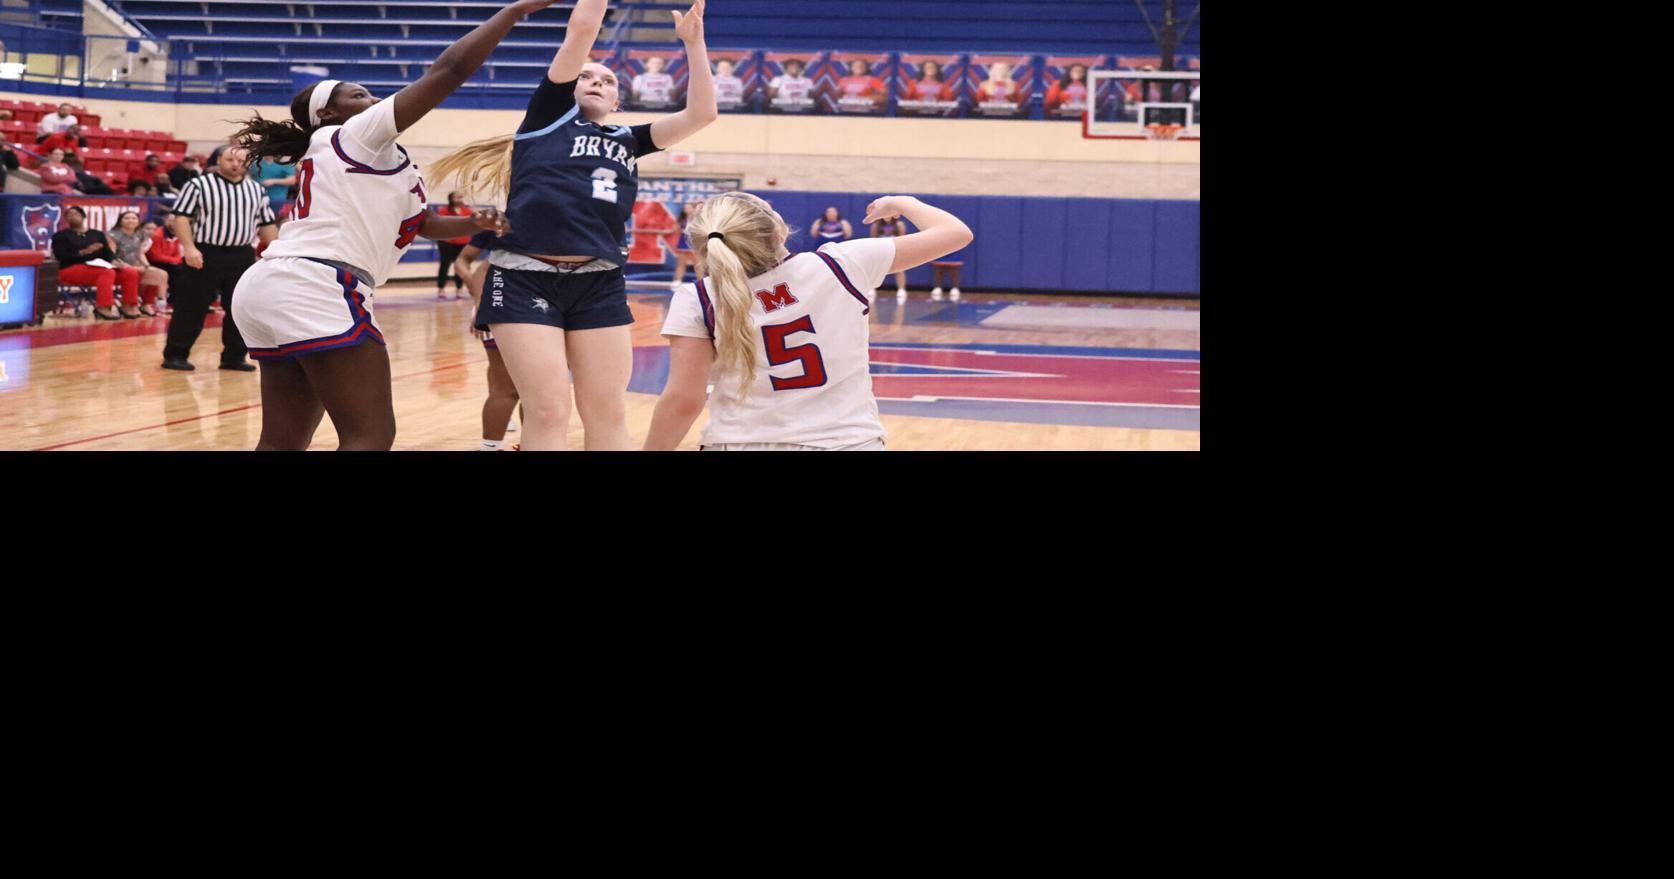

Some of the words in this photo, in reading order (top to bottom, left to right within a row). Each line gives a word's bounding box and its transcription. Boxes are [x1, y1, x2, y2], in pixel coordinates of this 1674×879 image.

[590, 166, 618, 204] 2
[754, 282, 799, 313] M
[761, 314, 828, 391] 5
